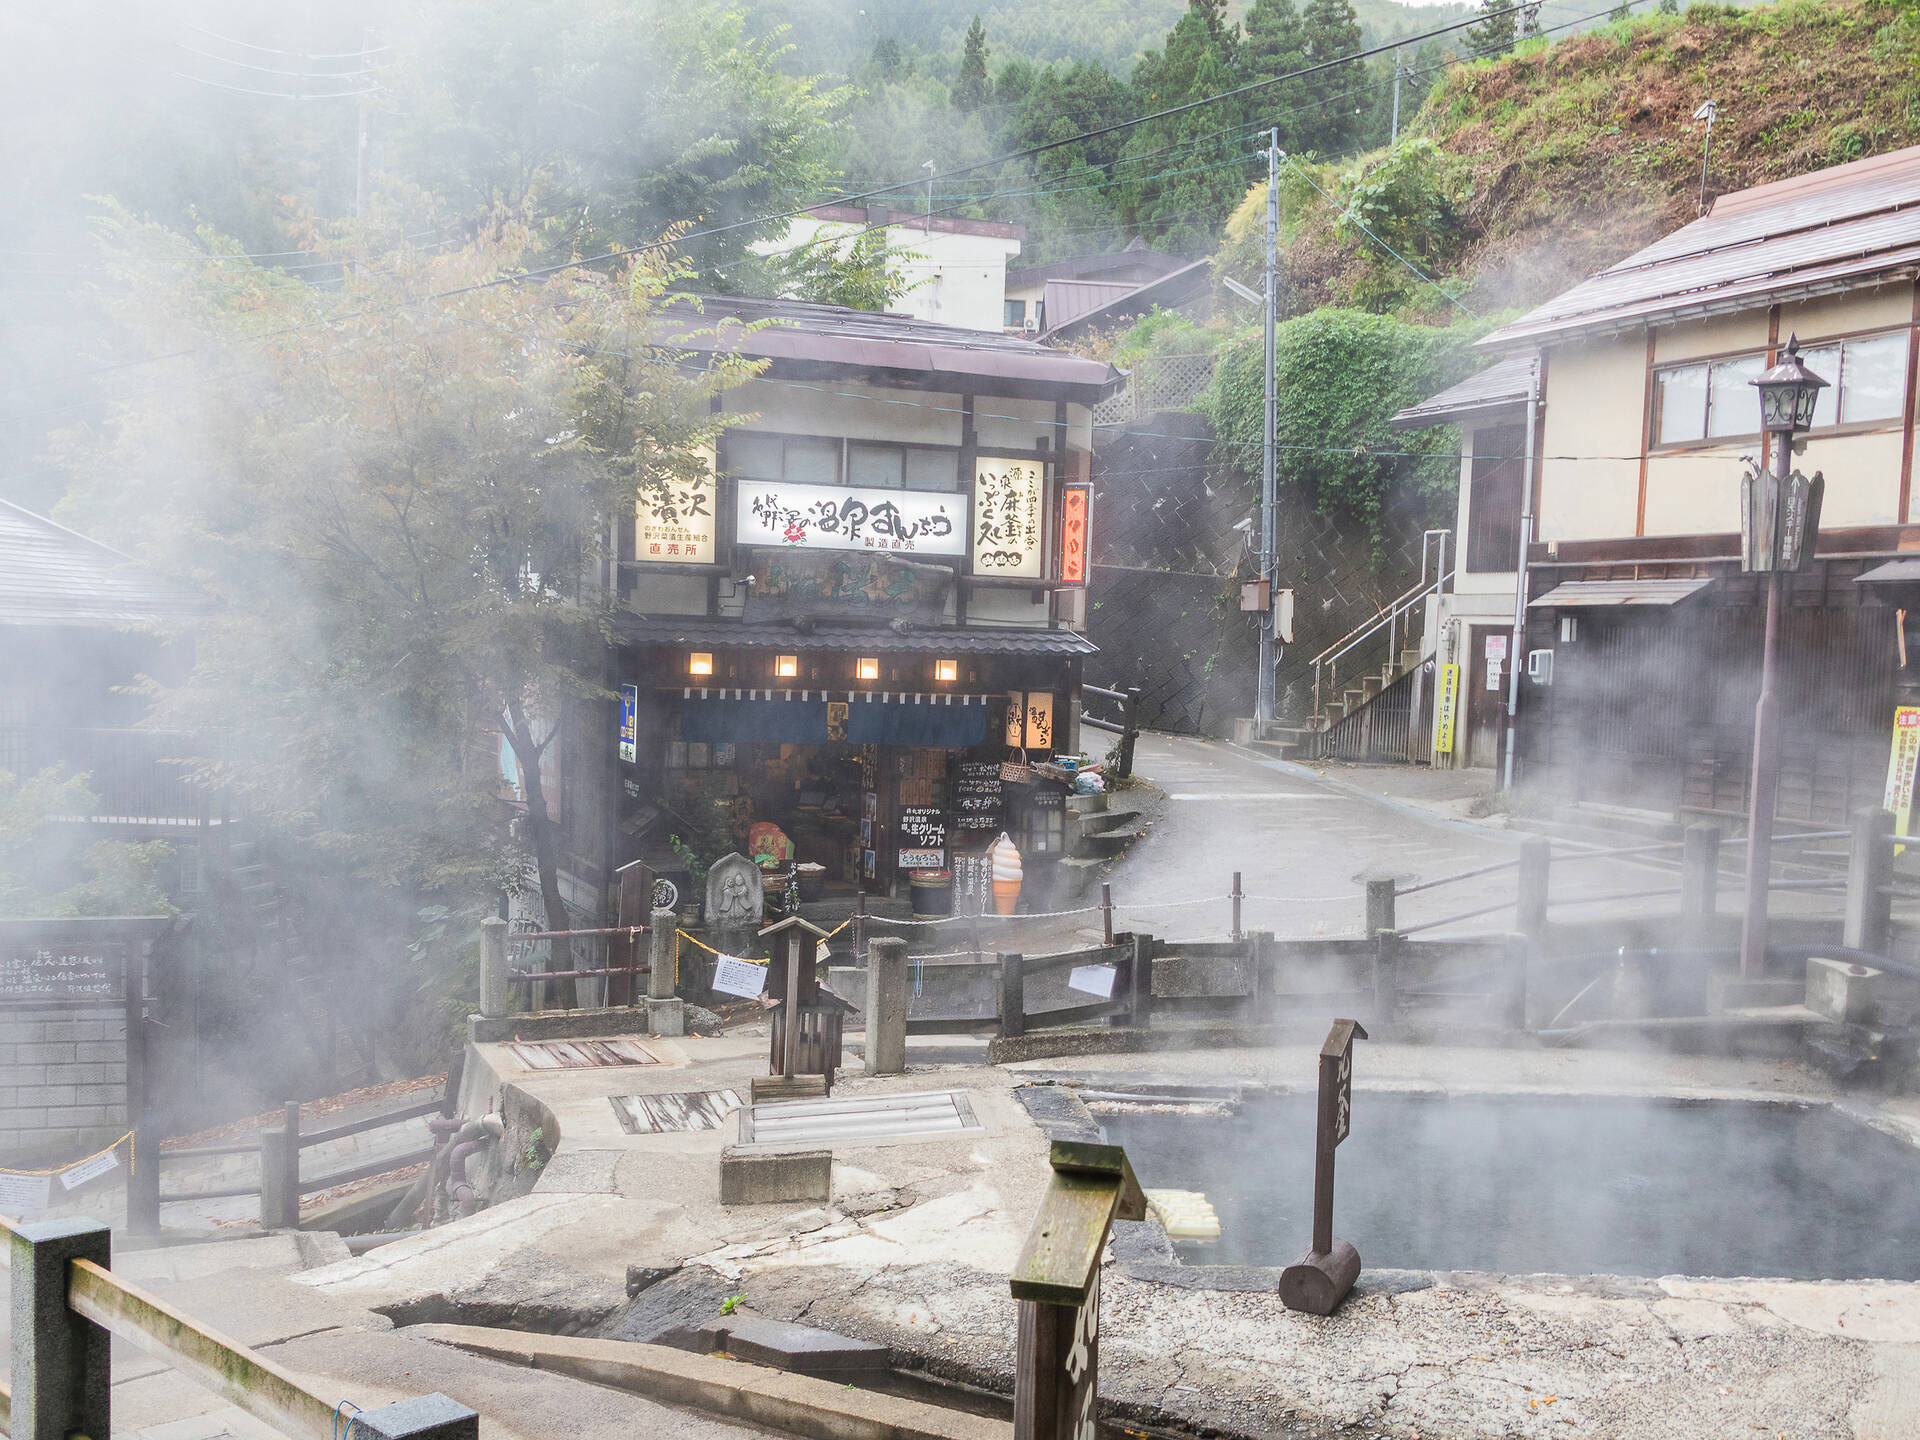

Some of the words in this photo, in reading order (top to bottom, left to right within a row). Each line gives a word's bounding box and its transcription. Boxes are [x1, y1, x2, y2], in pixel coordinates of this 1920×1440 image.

[649, 542, 697, 556] 直売所
[864, 536, 915, 551] 製造直売
[920, 835, 944, 846] ソフト
